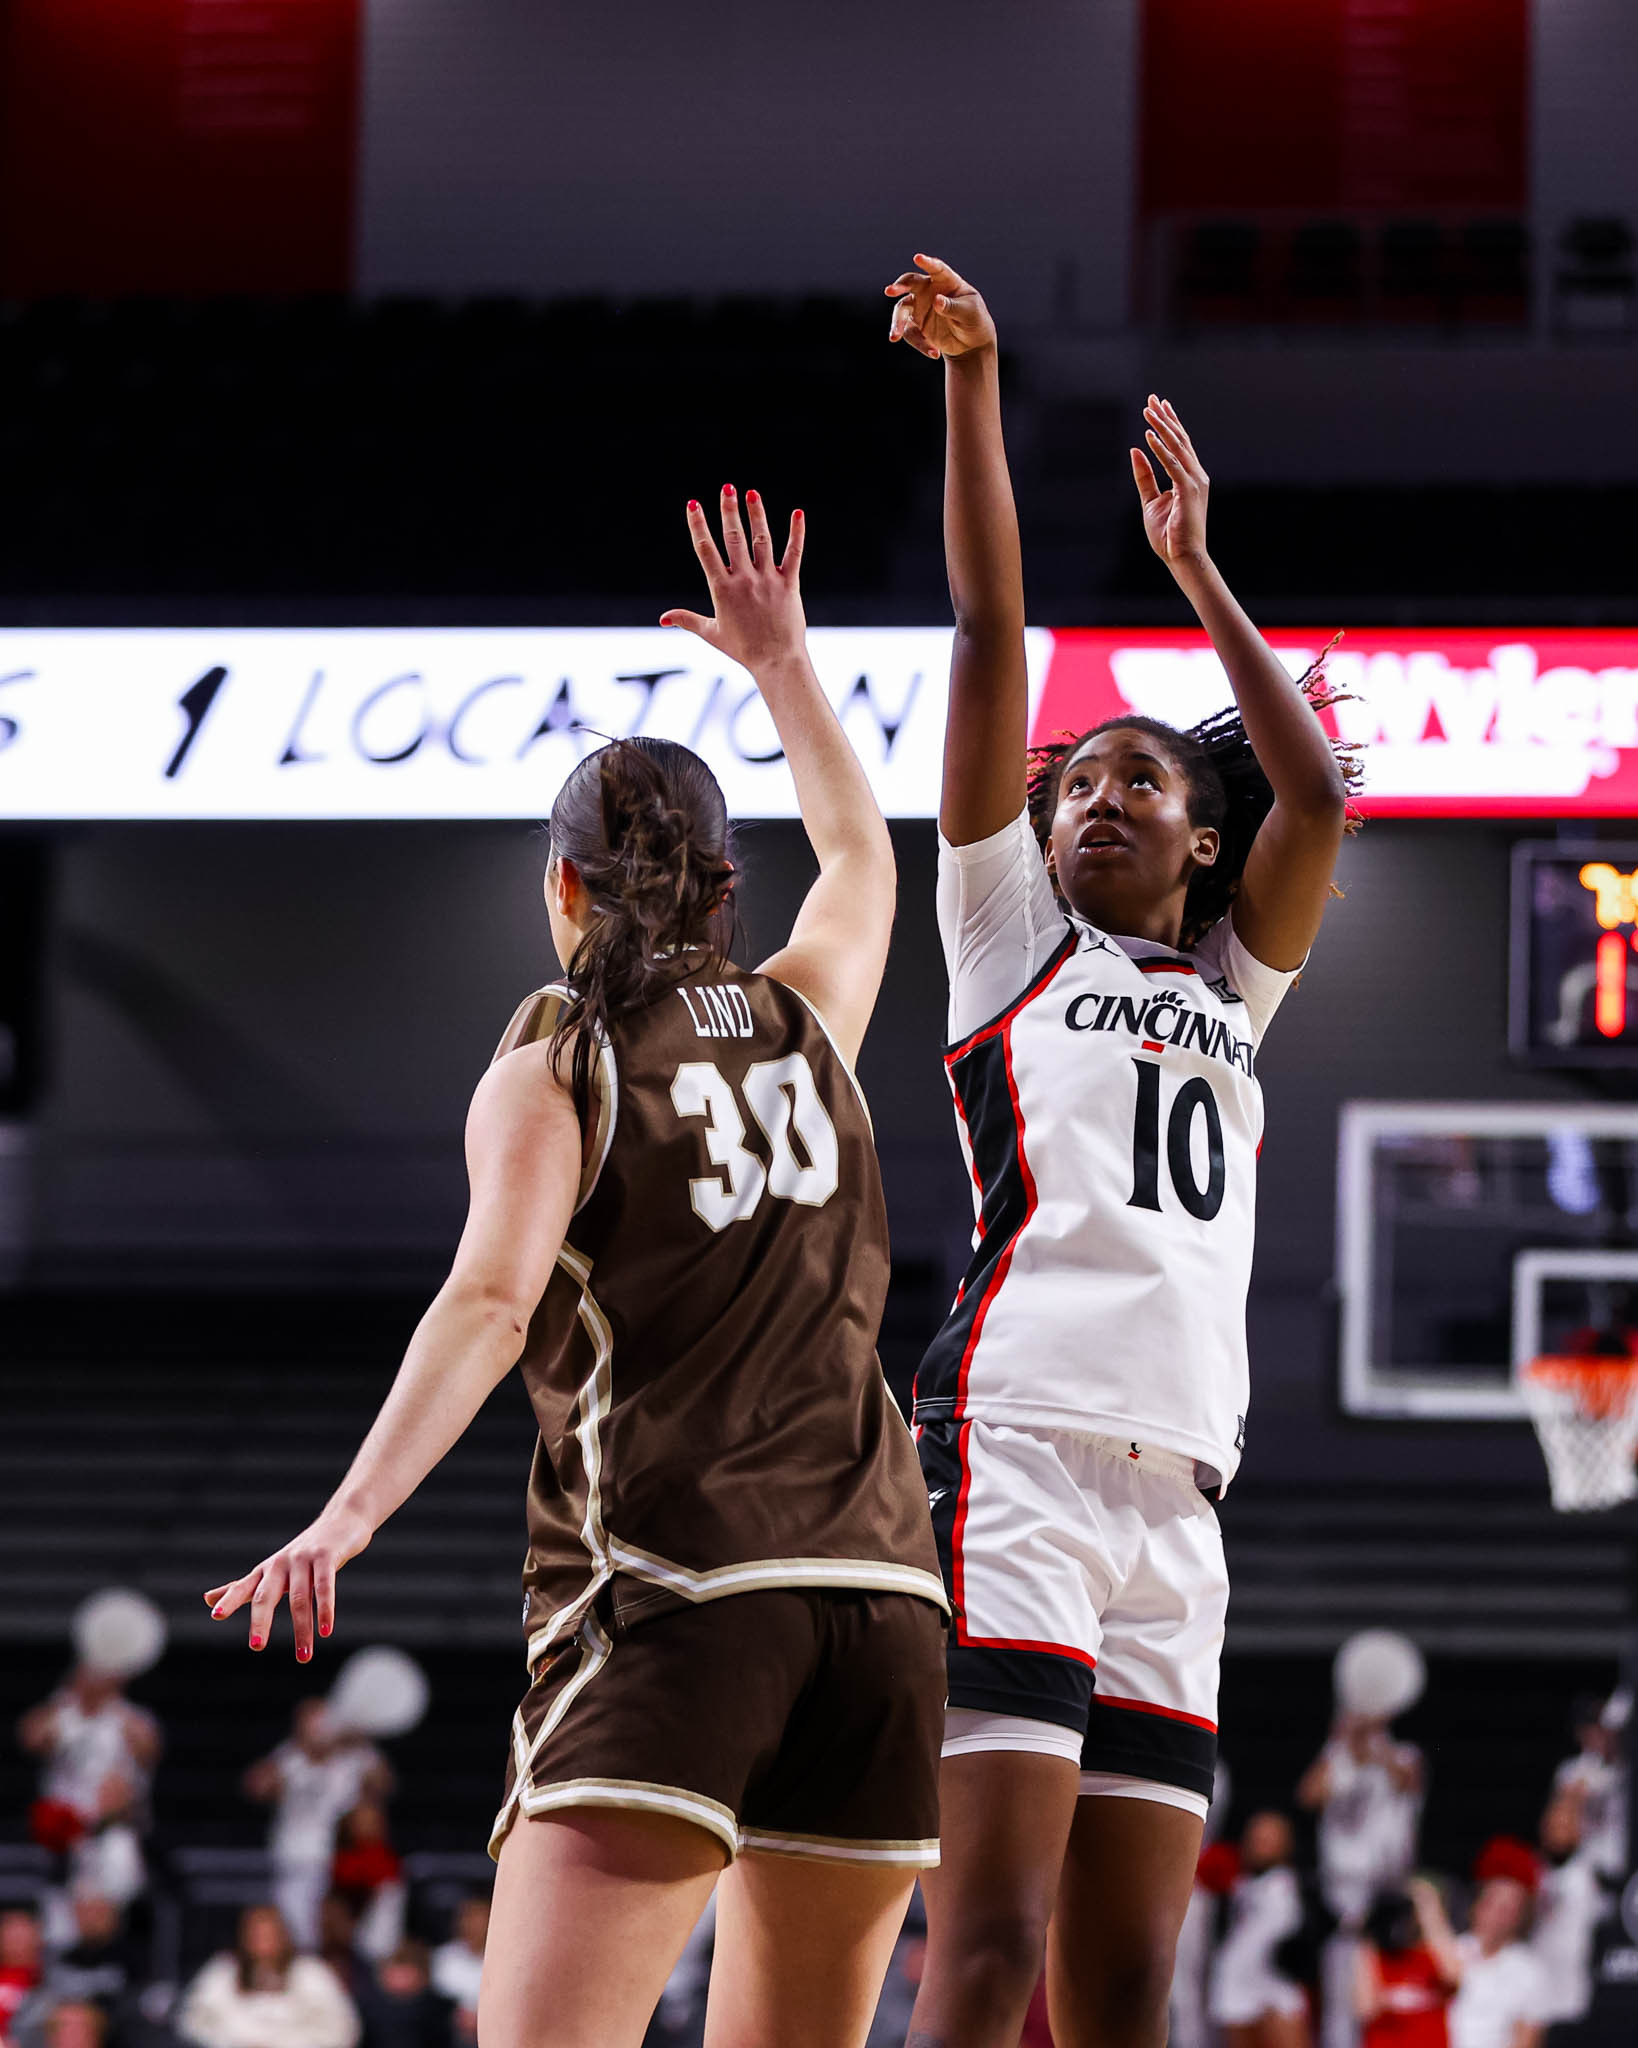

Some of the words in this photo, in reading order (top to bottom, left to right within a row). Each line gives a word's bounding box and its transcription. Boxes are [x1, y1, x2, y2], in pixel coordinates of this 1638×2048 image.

[278, 667, 921, 766] LOCATION
[676, 984, 753, 1037] LIND
[1064, 992, 1254, 1081] CINCINNAT
[669, 1051, 838, 1233] 30
[1126, 1057, 1225, 1221] 10
